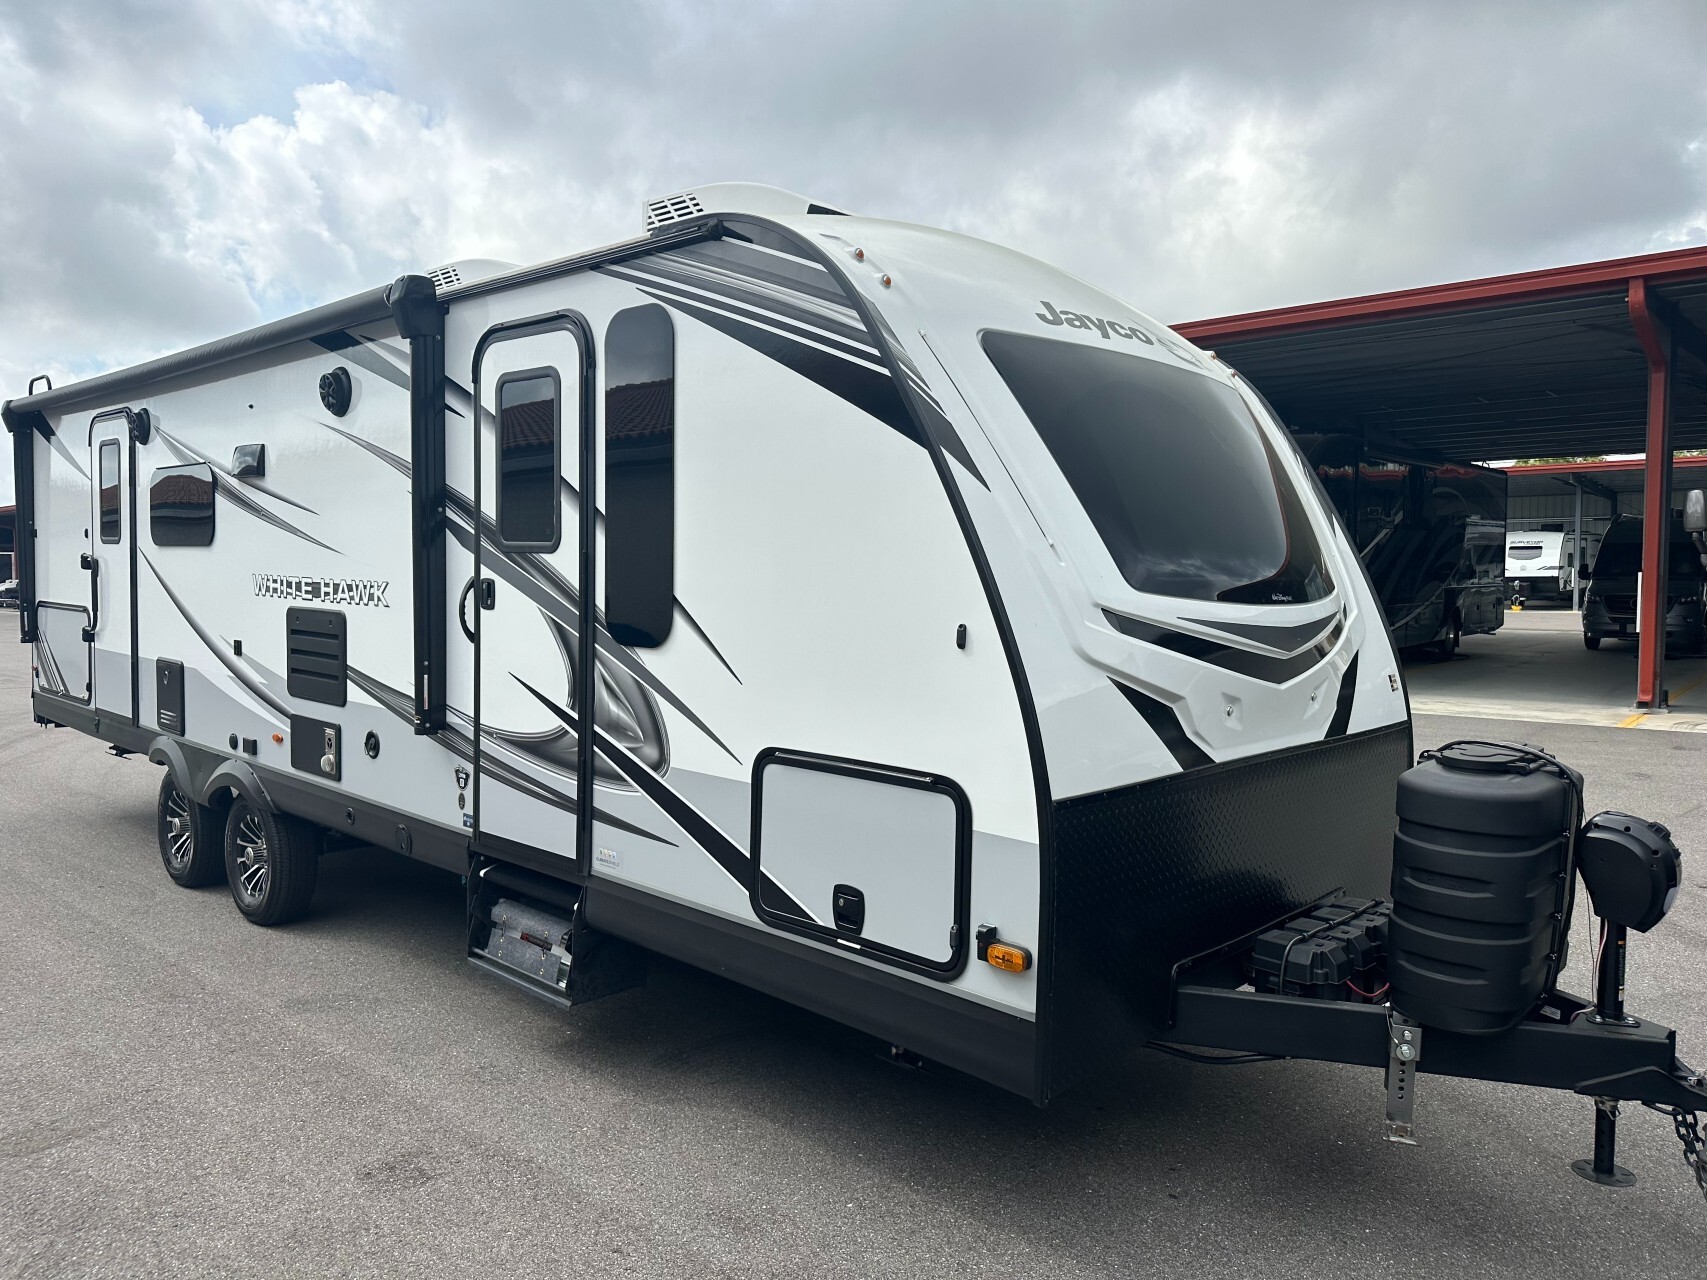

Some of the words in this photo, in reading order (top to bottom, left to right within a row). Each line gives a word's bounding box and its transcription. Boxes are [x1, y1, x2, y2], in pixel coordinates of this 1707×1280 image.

[1035, 300, 1154, 346] Jayco
[252, 573, 313, 601] WHITE
[320, 577, 390, 608] HAWK
